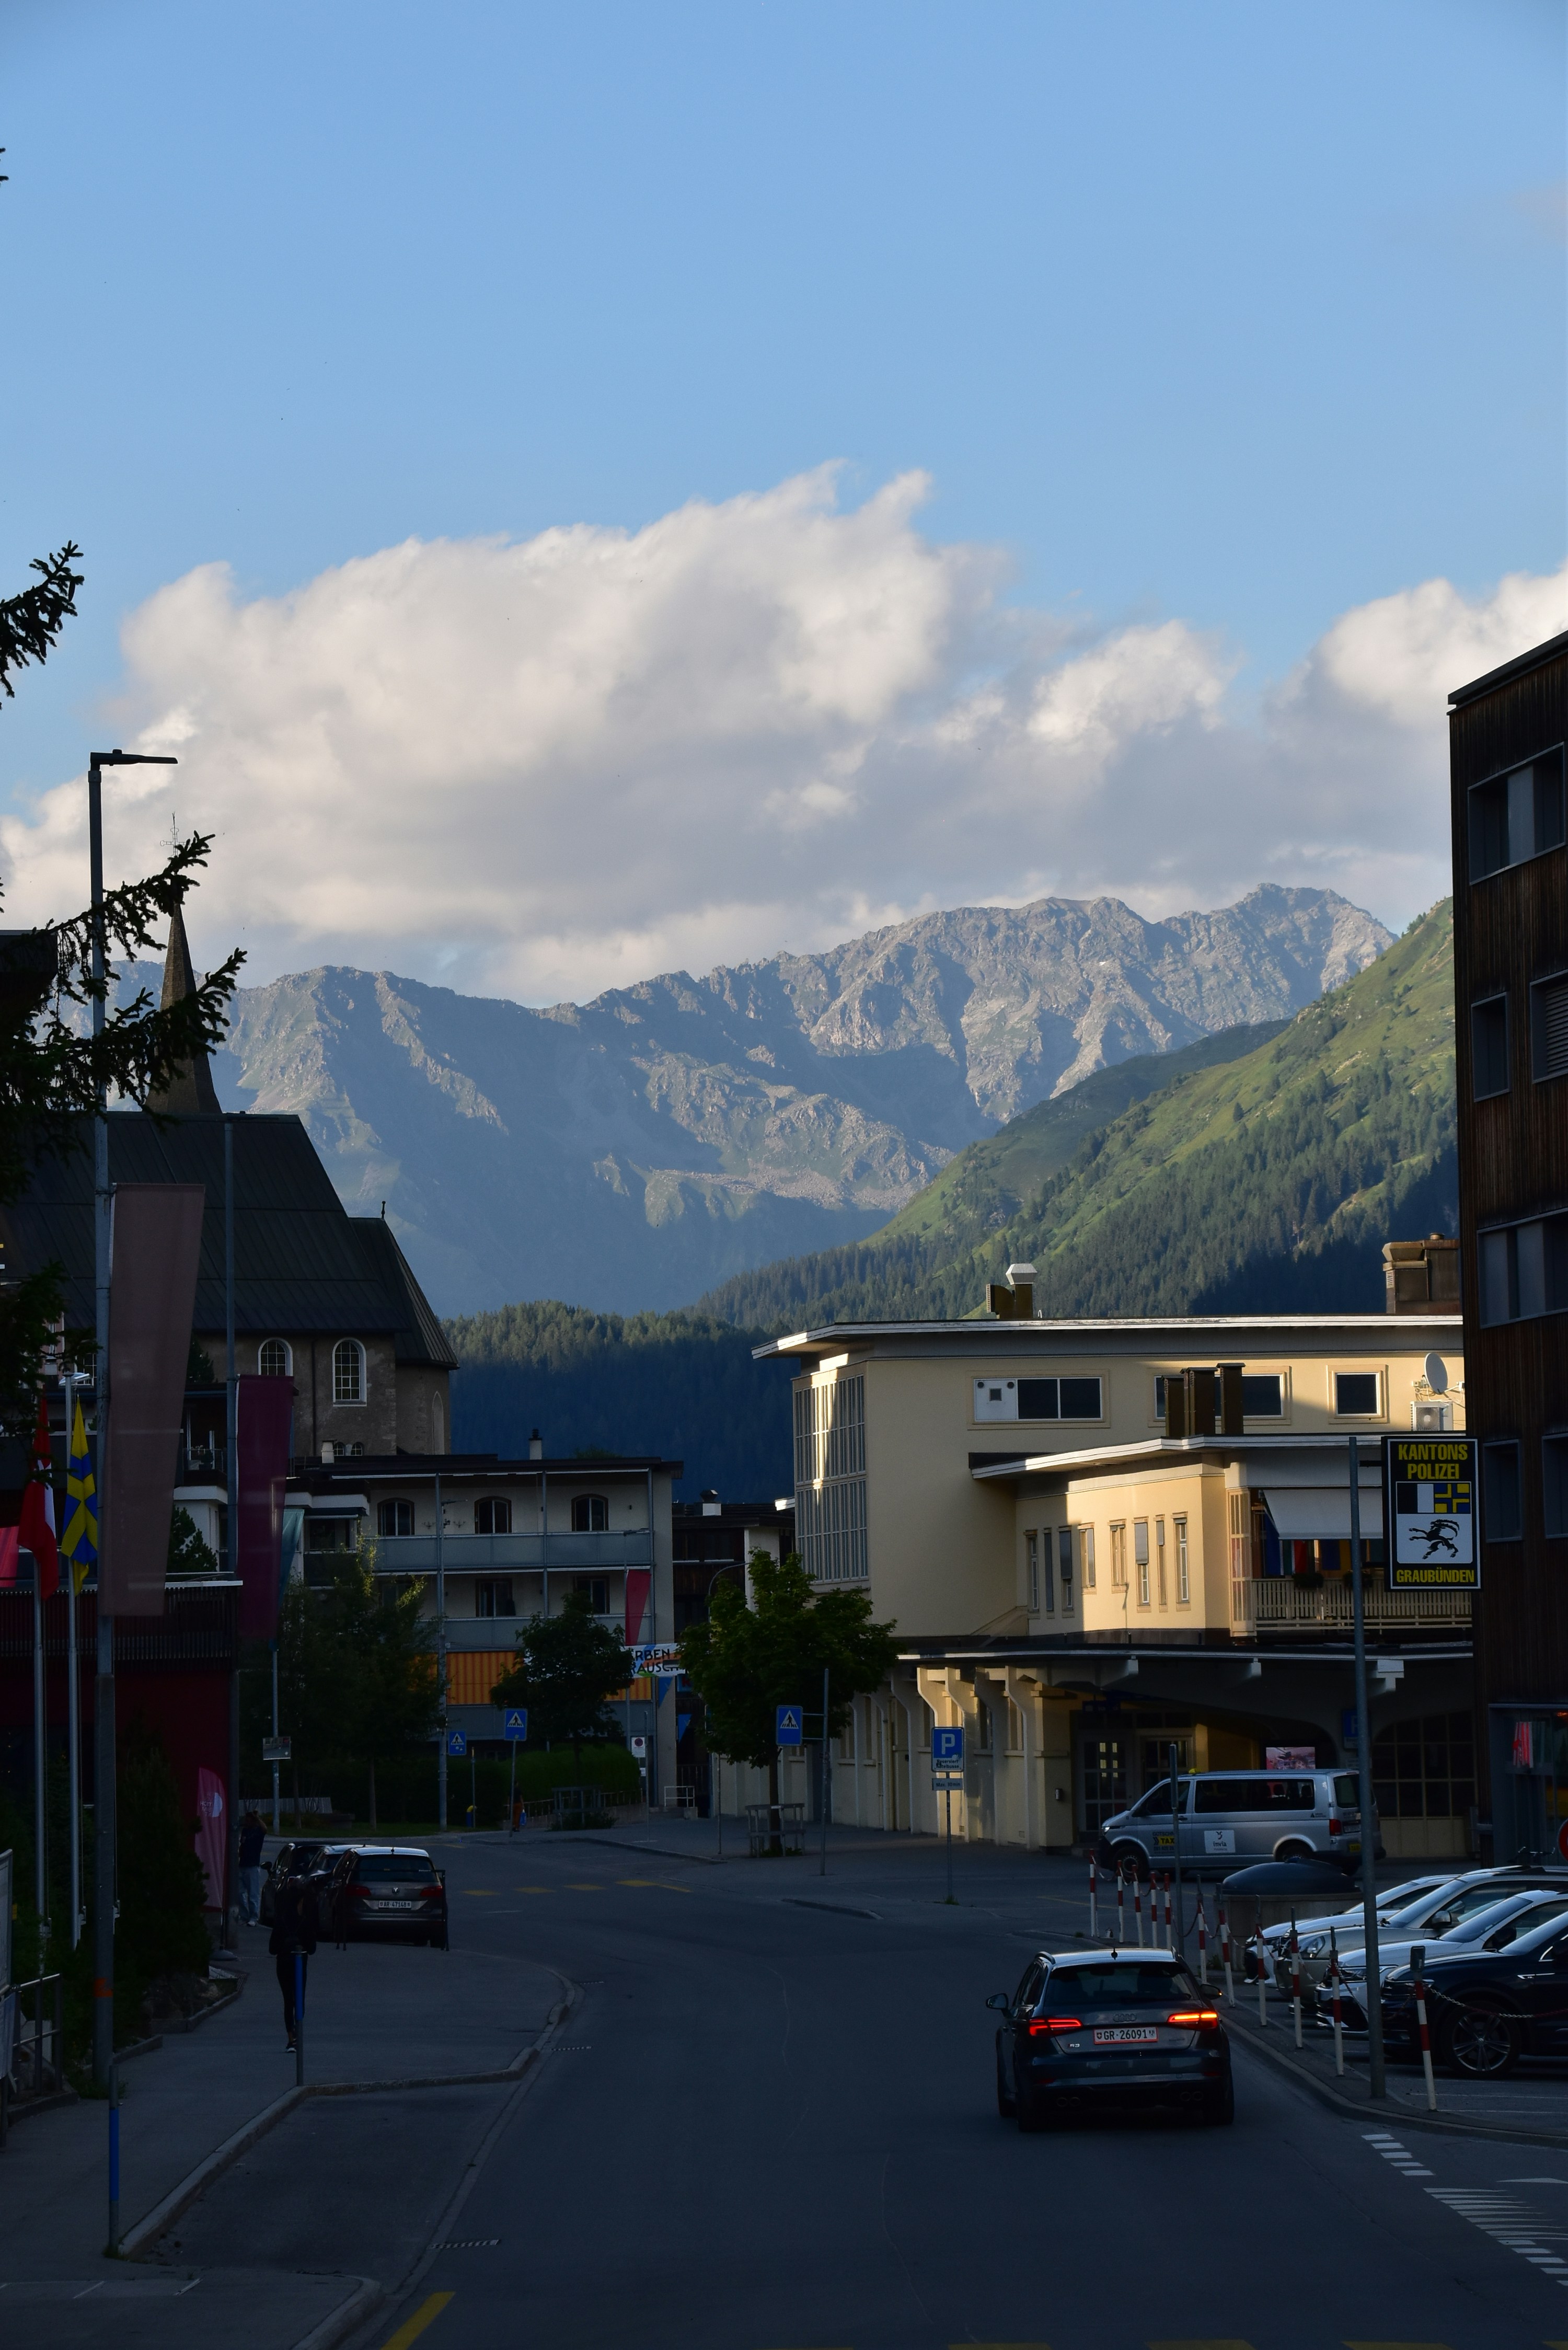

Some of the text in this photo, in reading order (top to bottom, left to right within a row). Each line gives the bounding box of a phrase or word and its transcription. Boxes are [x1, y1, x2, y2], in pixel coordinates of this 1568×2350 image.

[1398, 1444, 1468, 1461] KANTONS
[1407, 1463, 1460, 1480] POLIZEI
[1396, 1566, 1475, 1583] GRAUBÜNDEN
[634, 1649, 670, 1661] RBEN
[941, 1733, 955, 1755] P
